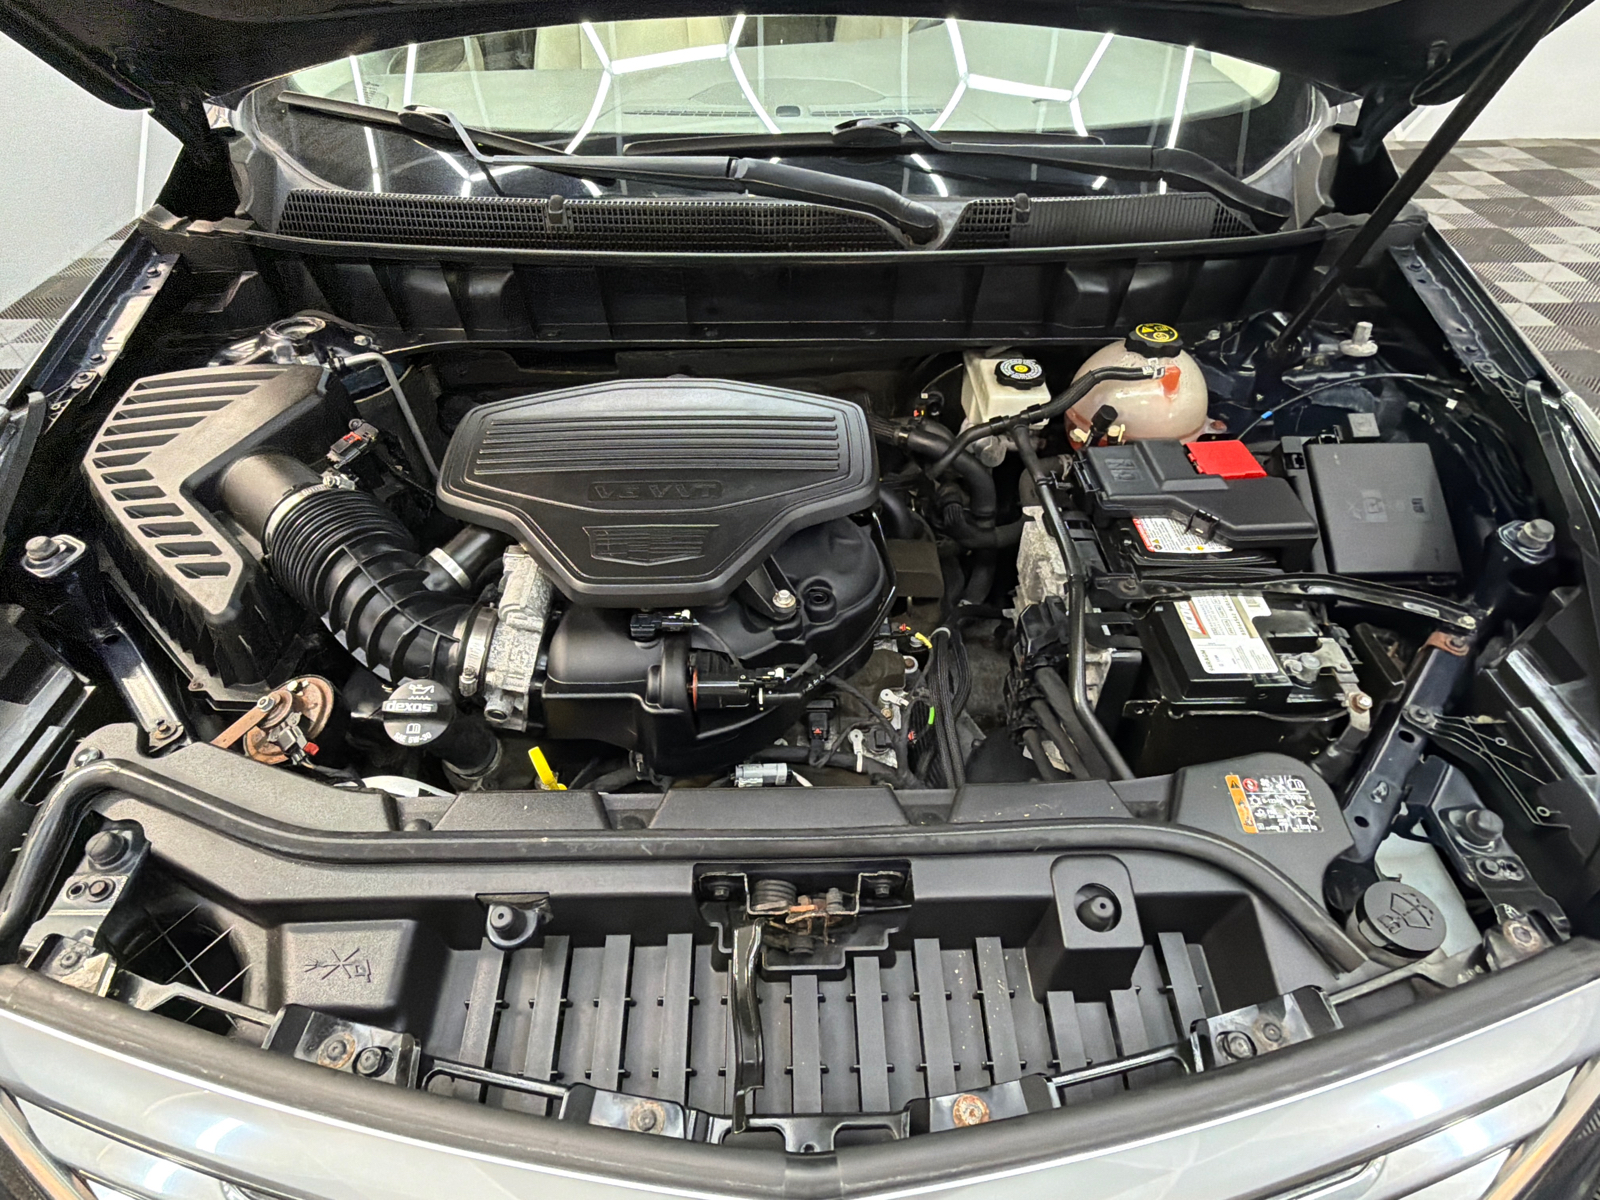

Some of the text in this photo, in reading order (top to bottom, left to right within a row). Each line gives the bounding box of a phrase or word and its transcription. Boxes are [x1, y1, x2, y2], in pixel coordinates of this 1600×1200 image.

[648, 483, 718, 498] VVT
[385, 700, 434, 712] dexos
[408, 732, 432, 743] 5W-30
